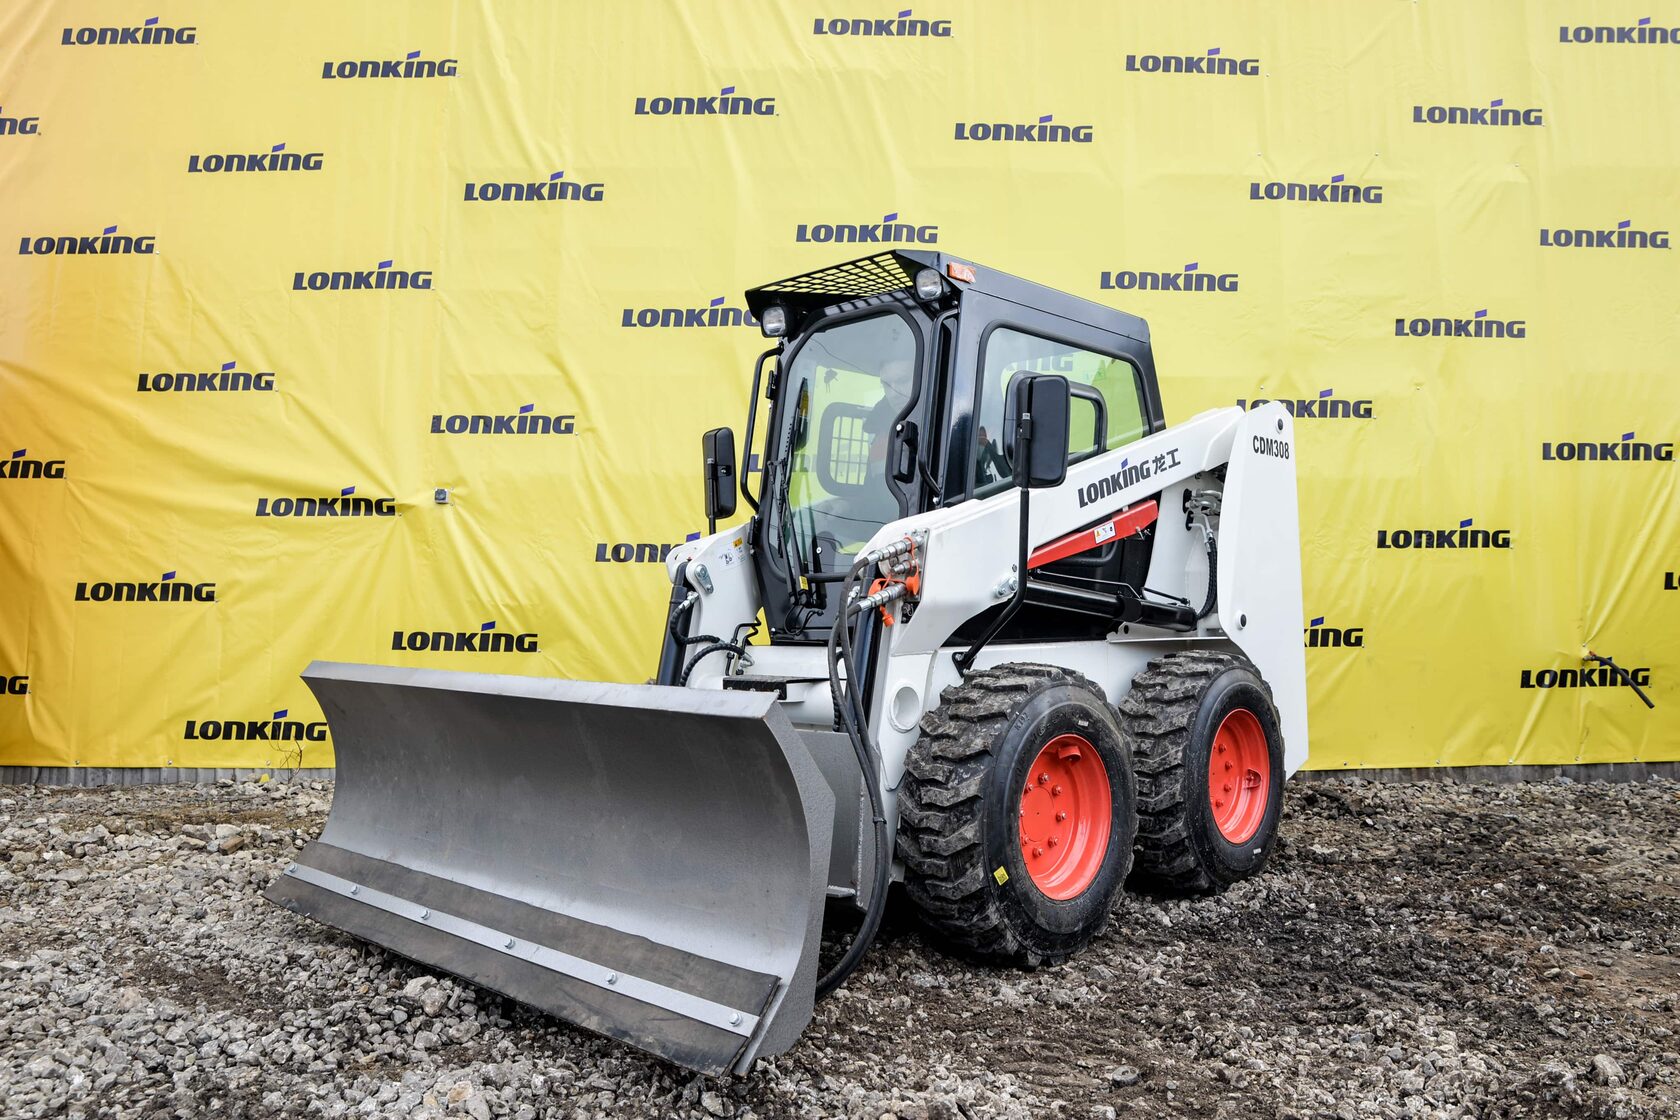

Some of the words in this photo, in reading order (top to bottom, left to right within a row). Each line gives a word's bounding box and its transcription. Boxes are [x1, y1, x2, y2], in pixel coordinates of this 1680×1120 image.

[62, 17, 196, 45] LONKING
[814, 10, 951, 36] LONKING
[322, 51, 457, 78] LONKING
[1126, 48, 1259, 75] LONKING
[635, 87, 775, 115] LONKING
[1414, 99, 1542, 125] LONKING
[955, 115, 1092, 142] LONKING
[188, 143, 323, 172] LONKING
[464, 172, 604, 201] LONKING
[1250, 175, 1382, 203] LONKING
[19, 226, 155, 254] LONKING
[796, 213, 937, 243] LONKING
[1540, 220, 1668, 248] LONKING
[293, 260, 432, 290] LONKING
[1101, 263, 1238, 291] LONKING
[1395, 310, 1525, 338] LONKING
[137, 362, 274, 392] LONKING
[431, 404, 575, 434] LONKING
[1252, 435, 1290, 460] CDM308
[1543, 432, 1673, 461] LONKING
[1078, 458, 1151, 508] LONKING
[1152, 448, 1181, 475] 龙工
[256, 487, 395, 516] LONKING
[1377, 519, 1510, 549] LONKING
[75, 571, 215, 602] LONKING
[392, 621, 538, 652] LONKING
[184, 709, 327, 741] LONKING
